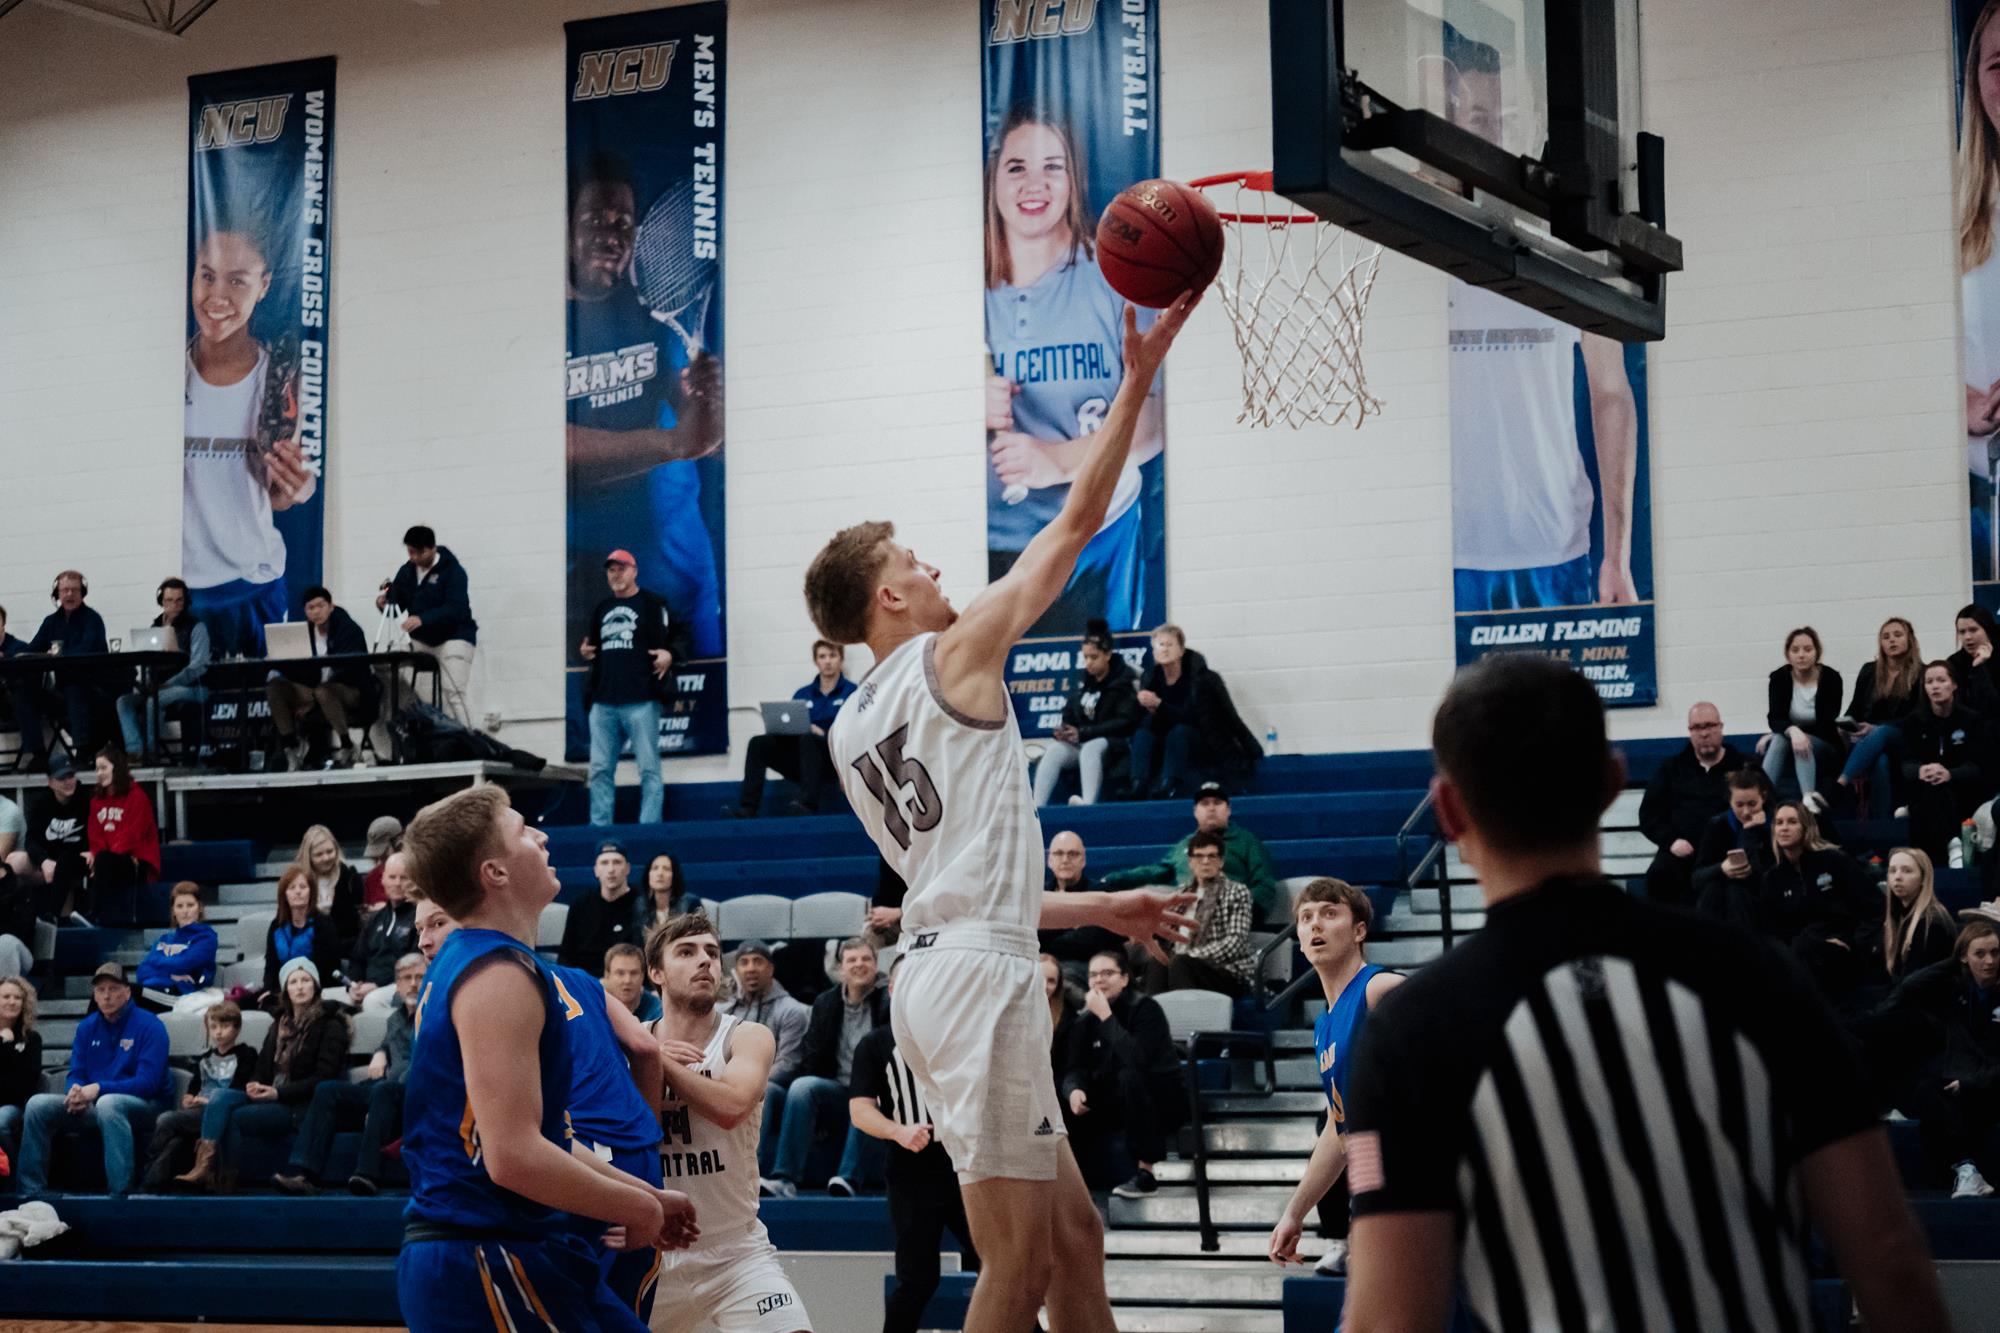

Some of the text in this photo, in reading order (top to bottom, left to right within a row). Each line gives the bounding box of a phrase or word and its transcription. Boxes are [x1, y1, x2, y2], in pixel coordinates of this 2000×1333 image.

[988, 0, 1098, 45] NCU
[575, 41, 678, 101] NCU
[197, 94, 292, 152] NCU
[693, 33, 717, 260] MEN'S TENNIS
[300, 89, 325, 478] WOMEN'S CROSS COUNTRY
[566, 350, 657, 398] RAMS
[1015, 342, 1111, 386] CENTRAL
[589, 383, 644, 409] TENNIS
[1470, 617, 1642, 646] CULLEN FLEMING
[1012, 651, 1072, 674] EMMA
[1009, 678, 1055, 694] THREE
[1594, 682, 1635, 698] DIES
[851, 722, 943, 851] 15
[660, 1149, 726, 1178] NTRAL
[757, 1293, 793, 1316] NCU
